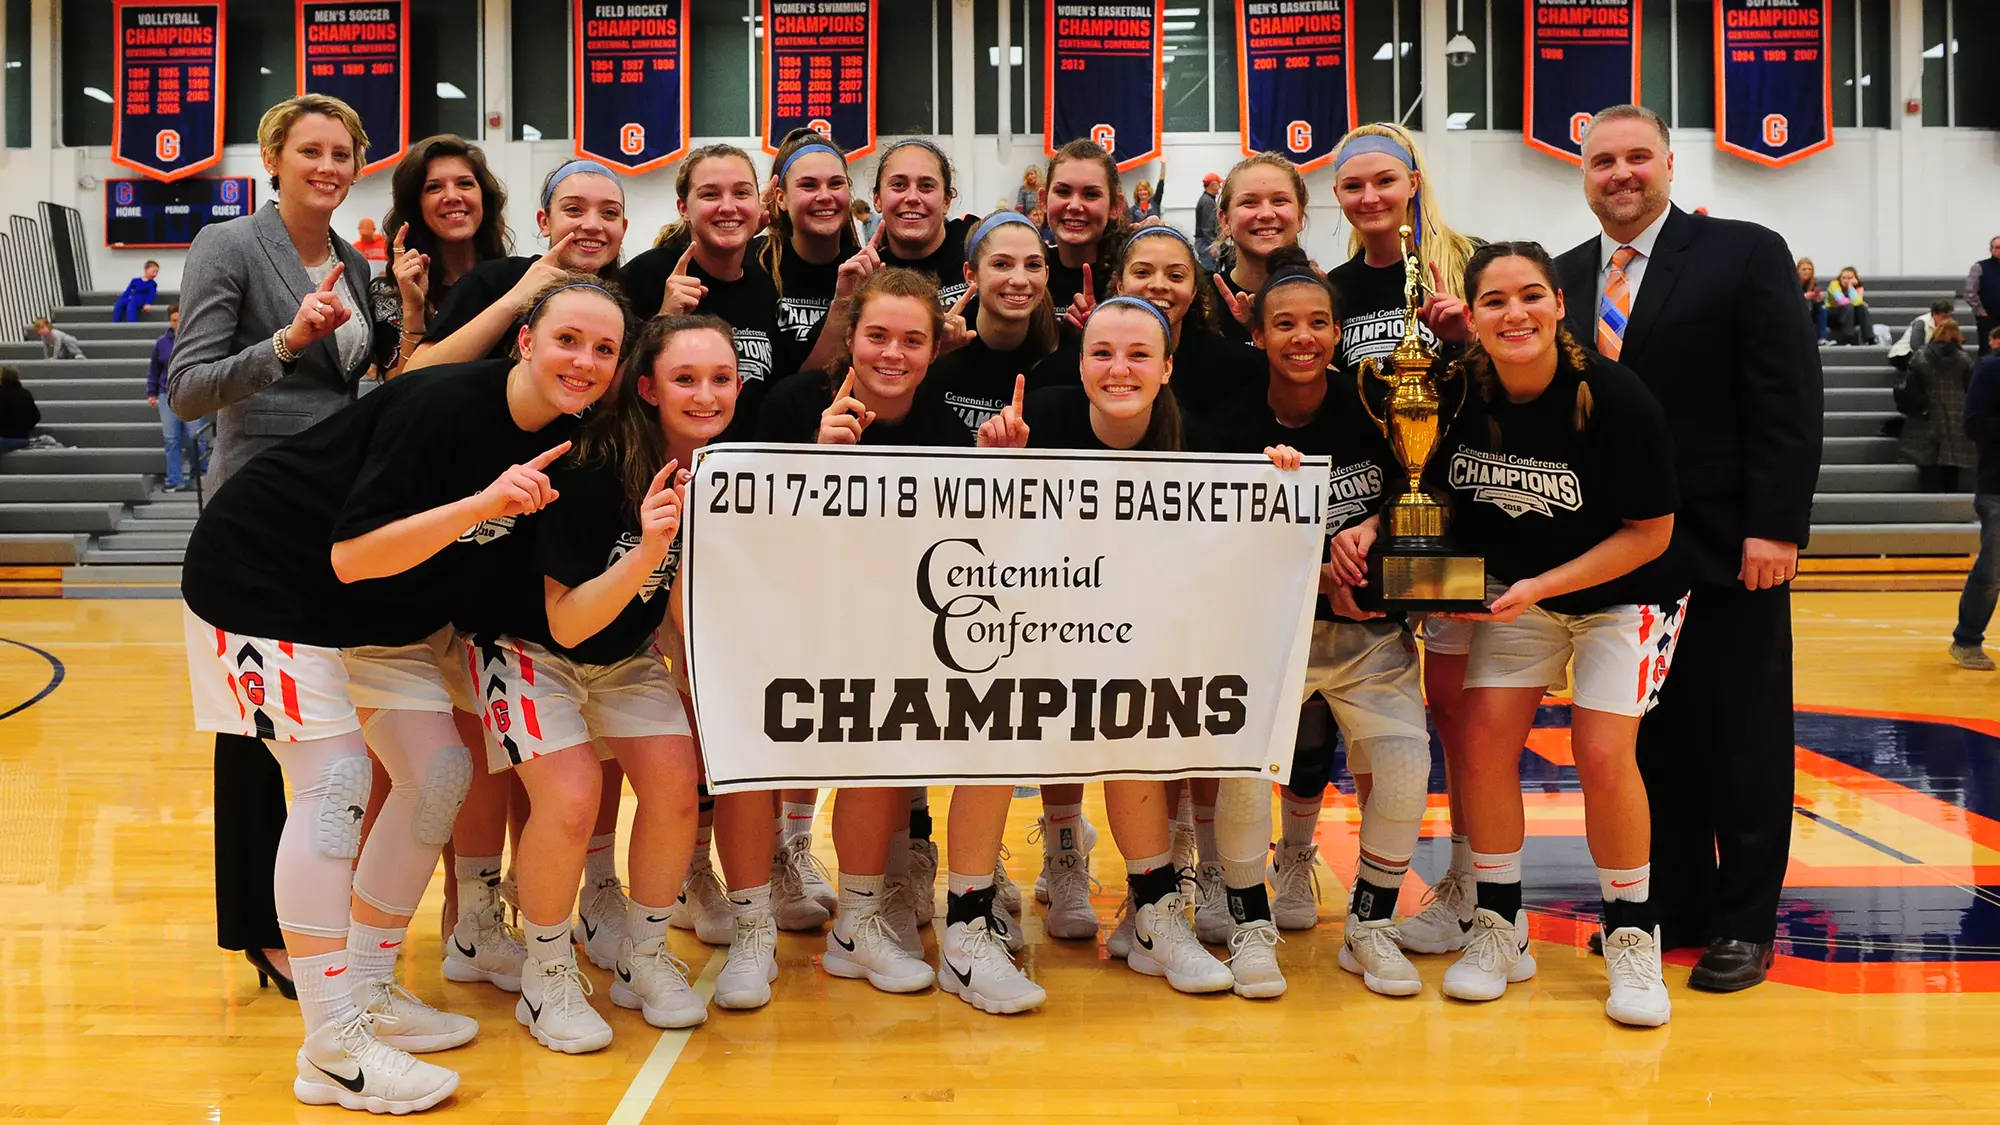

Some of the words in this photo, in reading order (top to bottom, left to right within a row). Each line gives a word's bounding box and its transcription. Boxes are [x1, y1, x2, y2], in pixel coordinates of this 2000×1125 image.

[315, 10, 346, 22] MEN'S
[349, 9, 390, 21] SOCCER
[596, 5, 624, 17] FIELD
[627, 4, 668, 17] HOCKEY
[774, 3, 816, 14] WOMEN'S
[818, 3, 866, 13] SWIMMING
[1058, 6, 1096, 16] WOMEN'S
[1098, 6, 1152, 17] BASKETBALL
[1249, 3, 1278, 14] MEN'S
[1280, 1, 1339, 13] BASKETBALL
[138, 13, 200, 25] VOLLEYBALL
[1538, 7, 1629, 25] CHAMPIONS
[1728, 8, 1819, 27] CHAMPIONS
[308, 23, 396, 41] CHAMPIONS
[588, 19, 677, 37] CHAMPIONS
[775, 16, 864, 33] CHAMPIONS
[1059, 19, 1150, 37] CHAMPIONS
[1250, 14, 1342, 35] CHAMPIONS
[126, 27, 213, 44] CHAMPIONS
[775, 37, 817, 45] CENTENNIAL
[779, 56, 802, 67] 1994
[810, 56, 832, 67] 1995
[1254, 57, 1277, 70] 2001
[1285, 56, 1310, 69] 2002
[1794, 49, 1817, 61] 2007
[1061, 59, 1086, 70] 2013
[621, 72, 643, 83] 2001
[779, 69, 801, 80] 1997
[810, 69, 832, 80] 1998
[840, 68, 863, 79] 1999
[778, 81, 802, 92] 2000
[838, 80, 862, 91] 2007
[808, 93, 832, 104] 2009
[840, 93, 862, 104] 2011
[778, 106, 802, 117] 2012
[808, 106, 832, 117] 2013
[1287, 120, 1312, 152] G
[1762, 114, 1788, 146] G
[156, 129, 180, 162] G
[620, 123, 644, 155] G
[1091, 124, 1115, 154] G
[116, 206, 141, 217] HOME
[165, 206, 190, 214] PERIOD
[212, 205, 241, 216] GUEST
[945, 391, 992, 407] Centennial
[1458, 444, 1506, 462] Centennial
[1508, 454, 1568, 470] Conference
[1330, 460, 1371, 478] nference
[1454, 458, 1577, 505] CHAMPIONS
[710, 472, 918, 518] 2017-2018
[933, 477, 1099, 522] WOMEN'S
[1116, 480, 1321, 524] BASKETBALL
[1502, 502, 1522, 512] 2018
[1326, 520, 1340, 530] 018
[916, 538, 1105, 618] Centennial
[932, 594, 1133, 673] Conference
[239, 672, 265, 706] G
[491, 698, 511, 734] G
[764, 675, 1248, 743] CHAMPIONS
